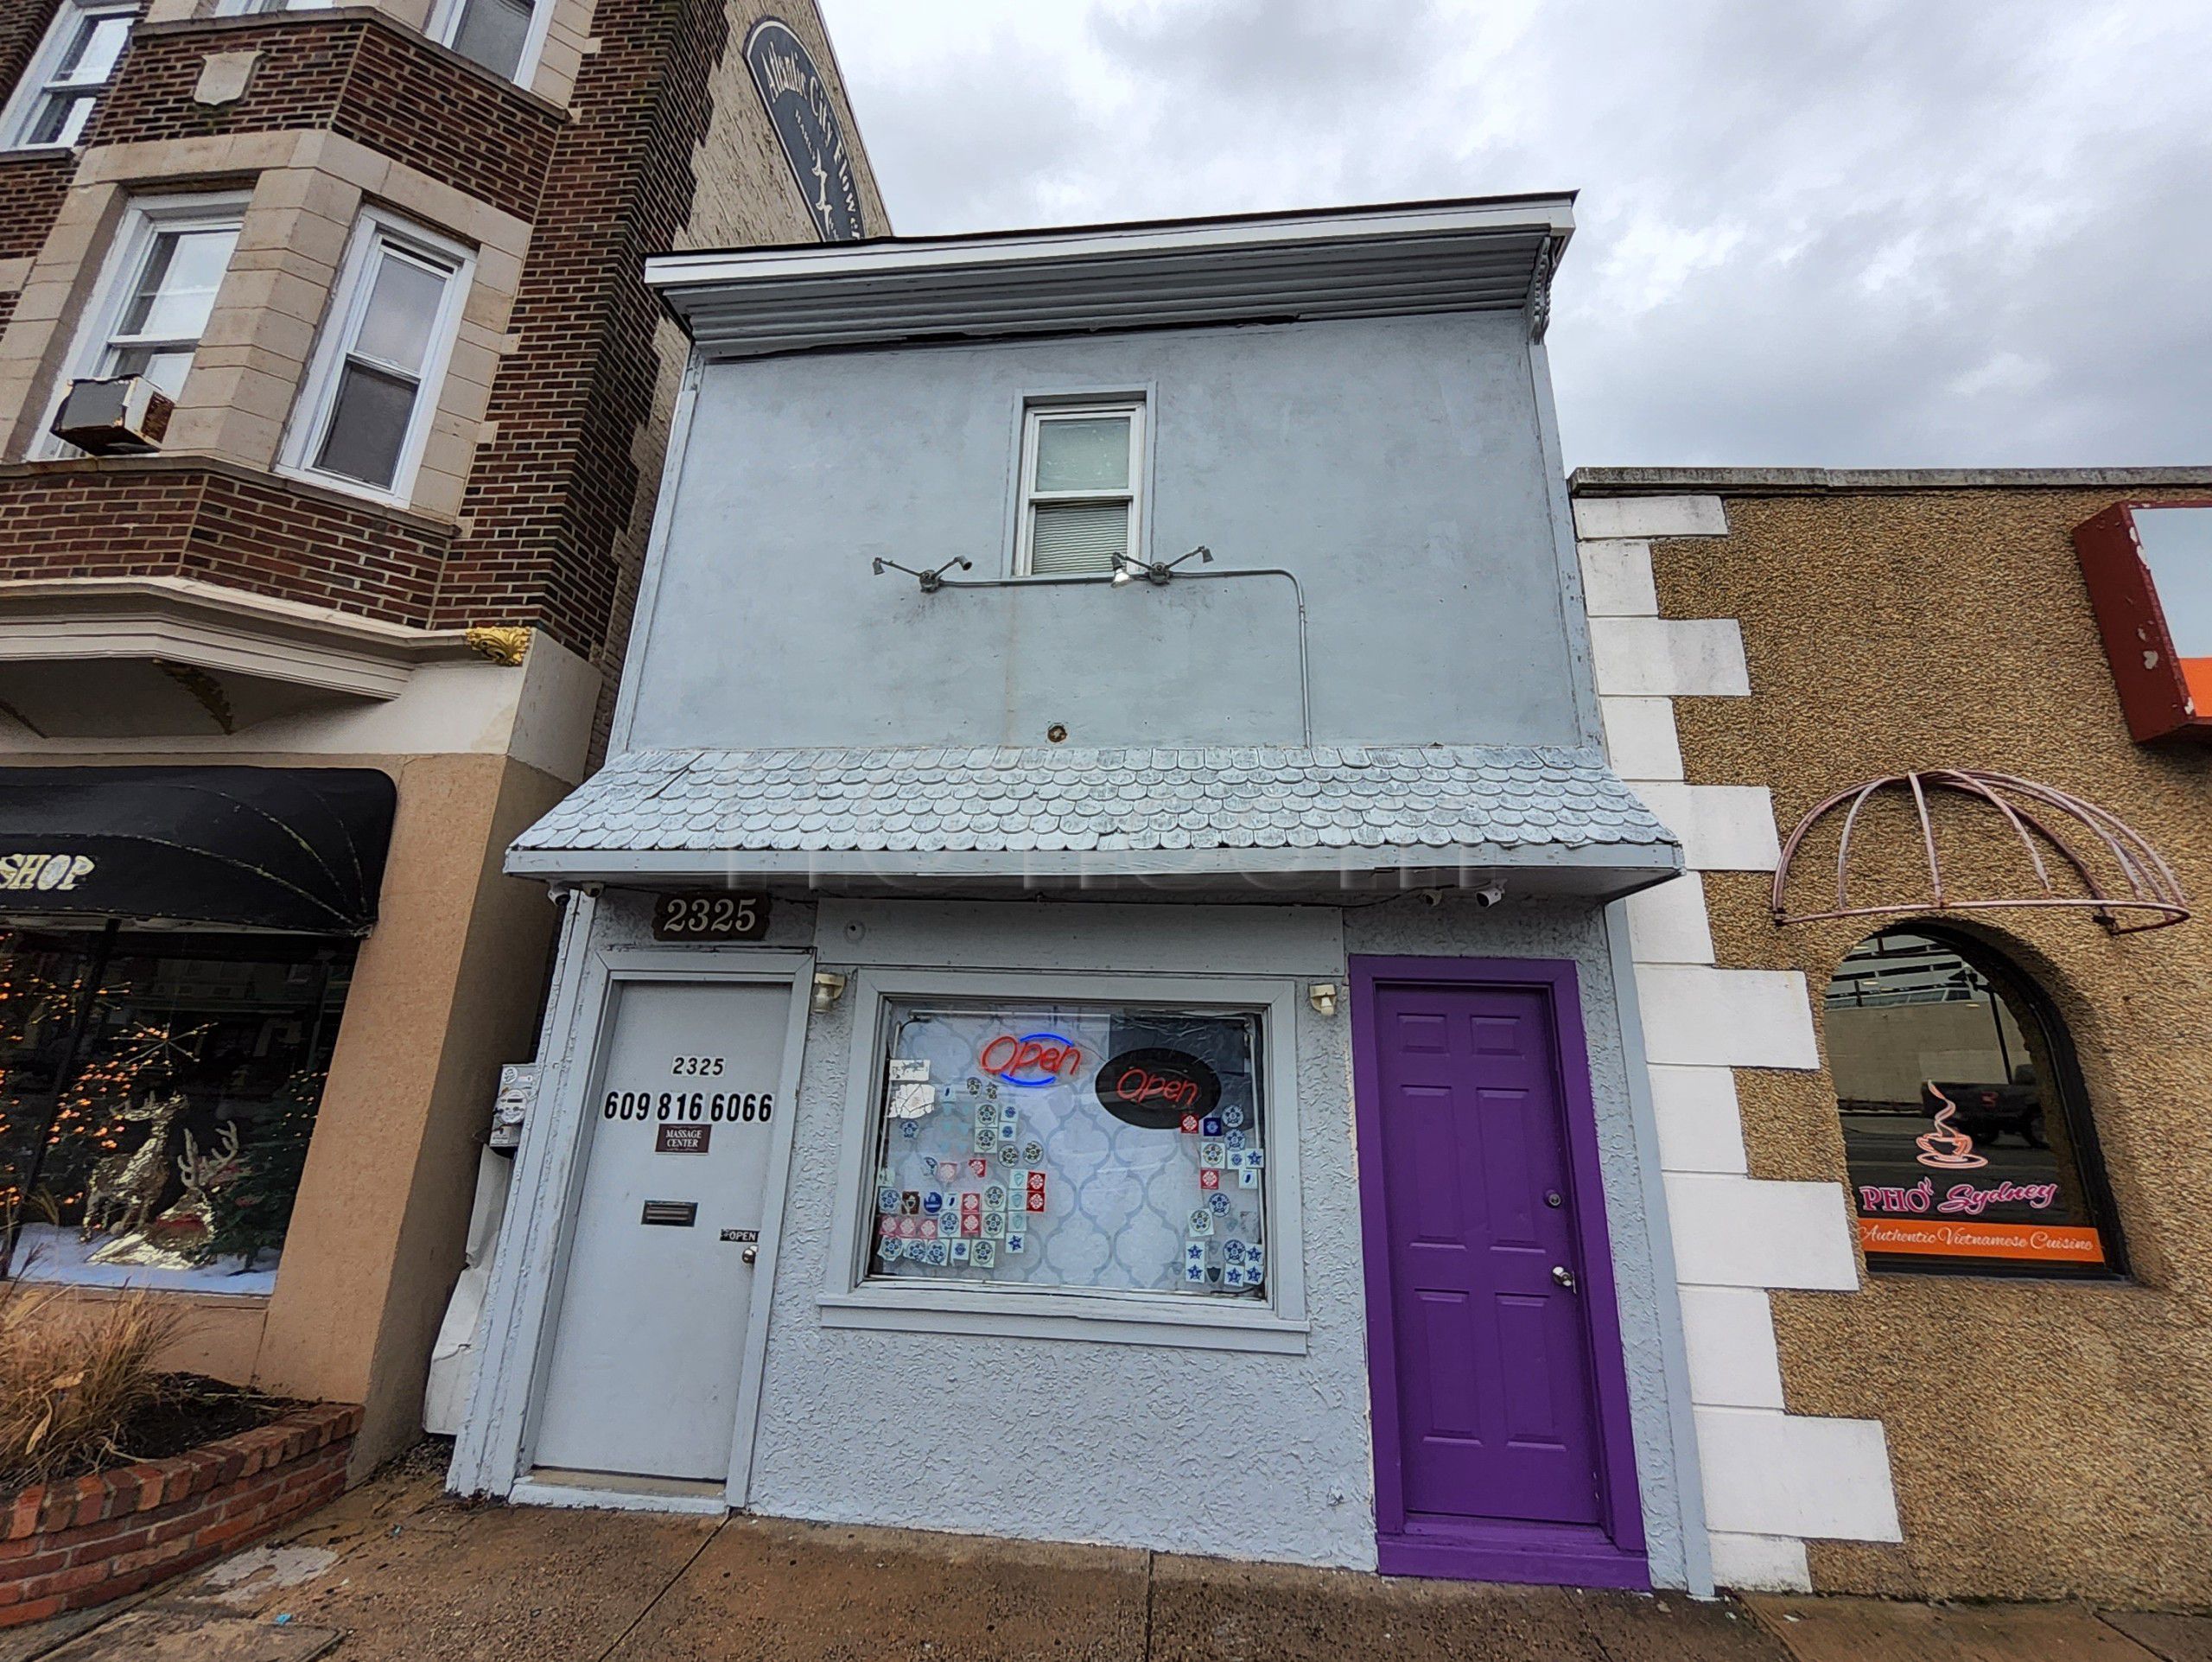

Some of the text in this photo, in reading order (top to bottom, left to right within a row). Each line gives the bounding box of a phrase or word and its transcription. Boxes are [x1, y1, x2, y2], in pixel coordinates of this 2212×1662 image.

[810, 76, 833, 147] City
[0, 853, 95, 890] SHOP
[663, 898, 757, 932] 2325
[672, 1057, 725, 1075] 2325
[980, 1035, 1081, 1077] Open
[1116, 1068, 1198, 1106] Open
[604, 1091, 773, 1122] 609 816 6066
[665, 1130, 702, 1139] MASSAGE
[666, 1138, 699, 1148] CENTER
[1937, 1181, 2058, 1215] Sydney
[729, 1231, 757, 1241] OPEN
[1858, 1224, 2094, 1251] Authentic Vietnamese Cuisine
